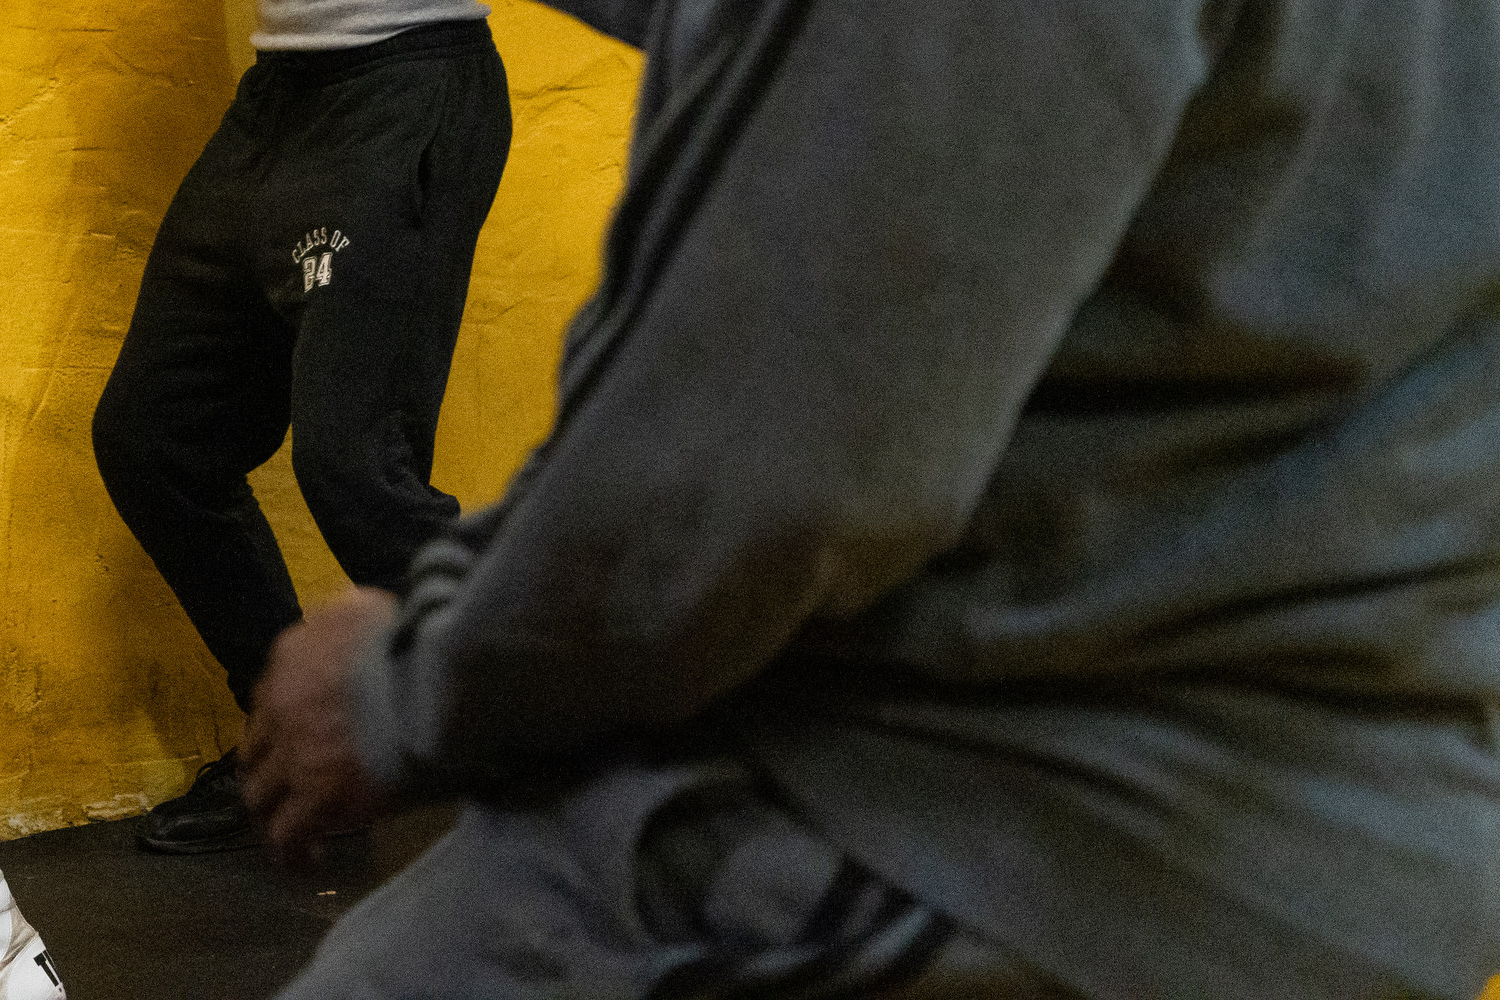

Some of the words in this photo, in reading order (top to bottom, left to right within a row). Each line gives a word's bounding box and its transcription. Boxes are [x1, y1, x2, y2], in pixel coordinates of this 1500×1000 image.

[291, 226, 328, 264] CLASS
[329, 229, 351, 252] OF
[302, 251, 334, 293] 24
